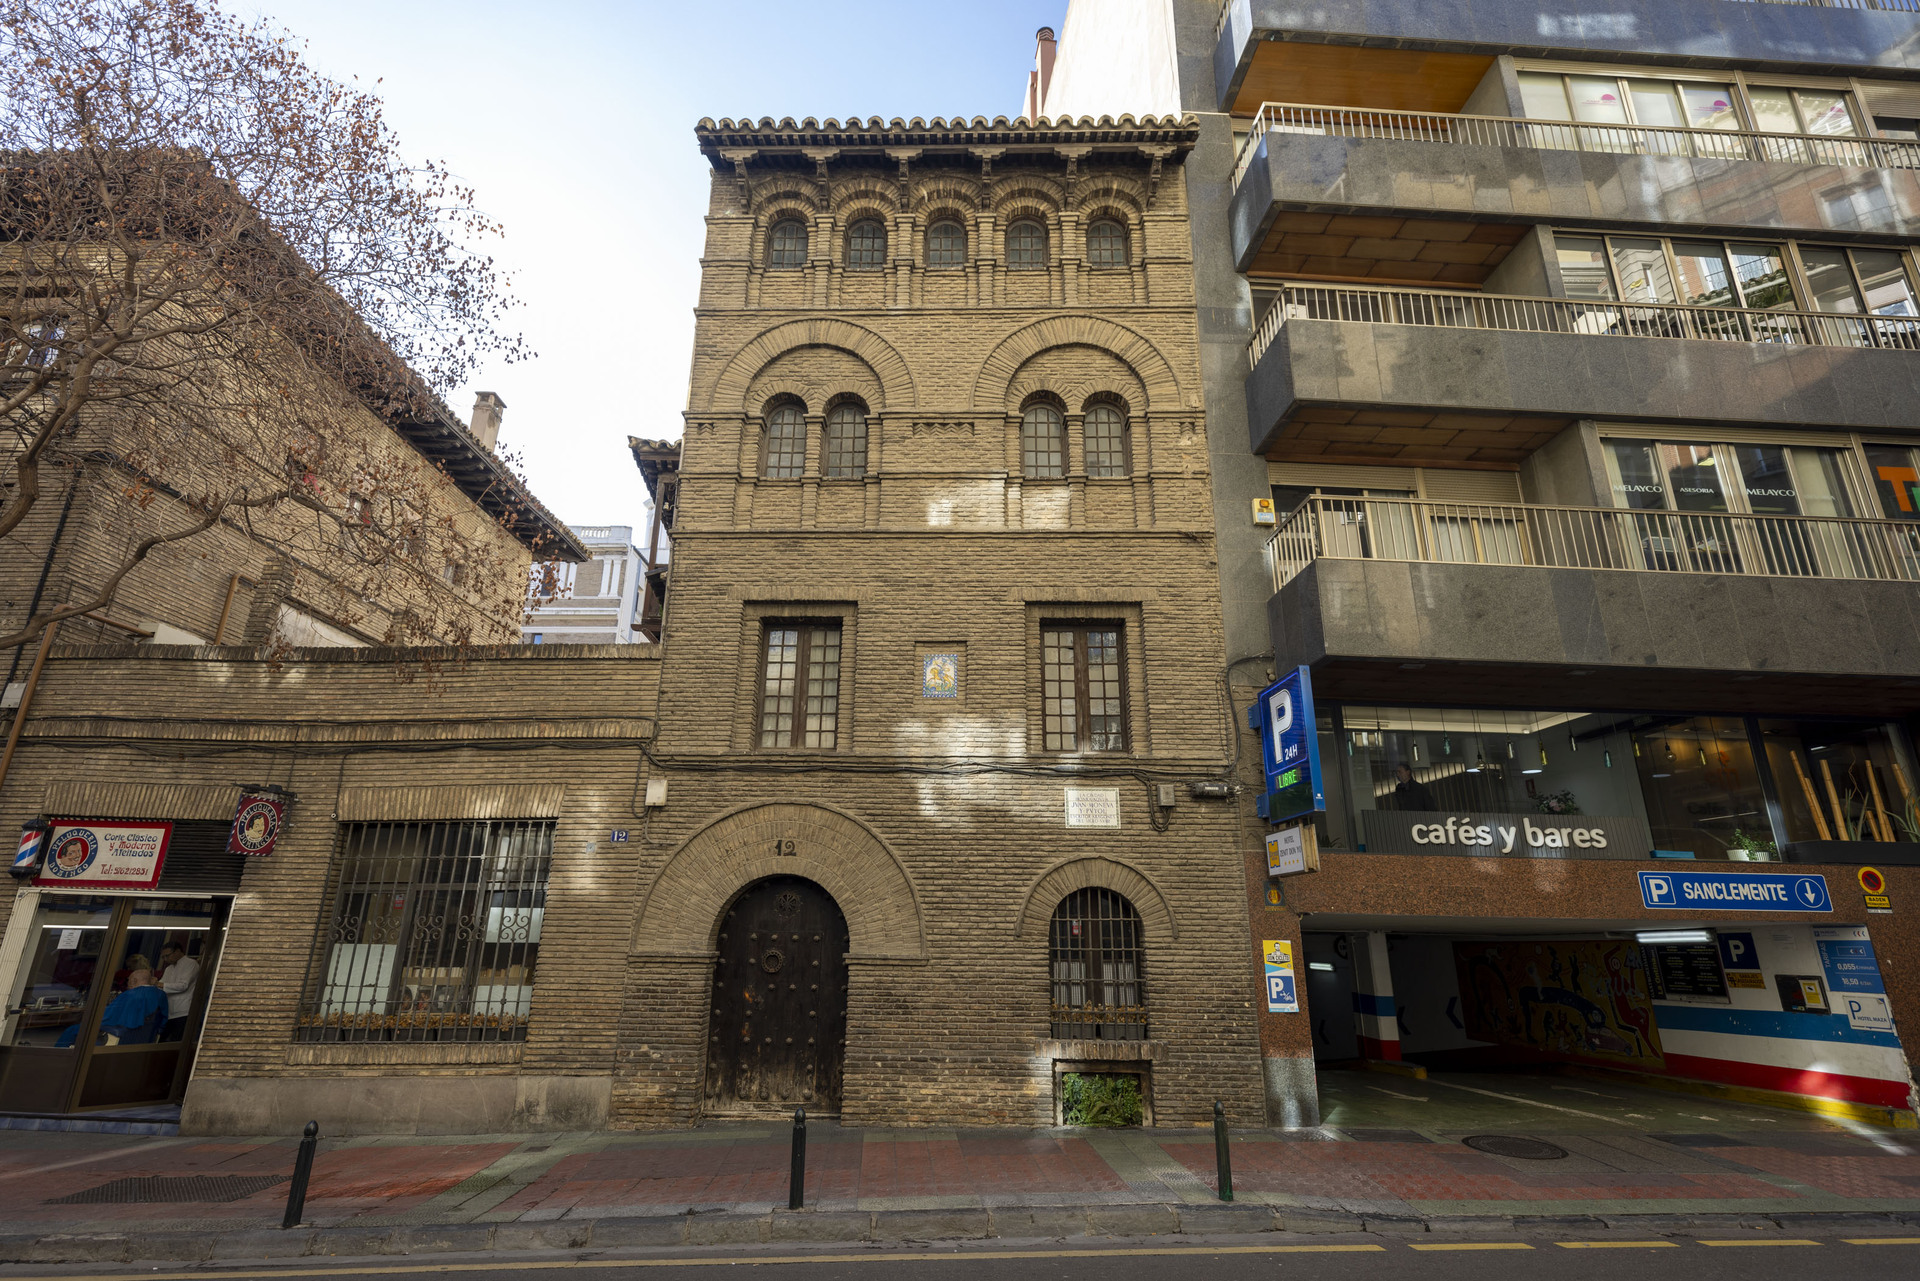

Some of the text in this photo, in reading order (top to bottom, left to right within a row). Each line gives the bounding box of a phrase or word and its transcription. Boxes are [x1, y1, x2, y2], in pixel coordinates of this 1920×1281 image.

[1613, 484, 1663, 493] MELAYCO
[1746, 487, 1796, 497] MELAYCO
[1269, 688, 1293, 764] P
[1284, 744, 1298, 761] 24H
[1278, 769, 1298, 789] LIBRE
[241, 803, 277, 828] PELUQUERIA
[52, 828, 98, 850] PELUQUERIA
[104, 833, 124, 842] Corte
[240, 833, 270, 849] DOMINGO
[613, 831, 627, 842] 12
[1411, 817, 1608, 854] cafés y bares
[109, 842, 116, 851] y
[111, 848, 154, 858] Afeitados
[774, 839, 797, 857] 12
[49, 861, 89, 878] DOMINGO
[1649, 879, 1788, 902] P SANCLEMENTE
[1728, 939, 1745, 963] P
[1837, 962, 1856, 971] 0,055
[1270, 977, 1284, 999] P
[1842, 977, 1859, 985] 18,50
[1848, 1000, 1862, 1020] P
